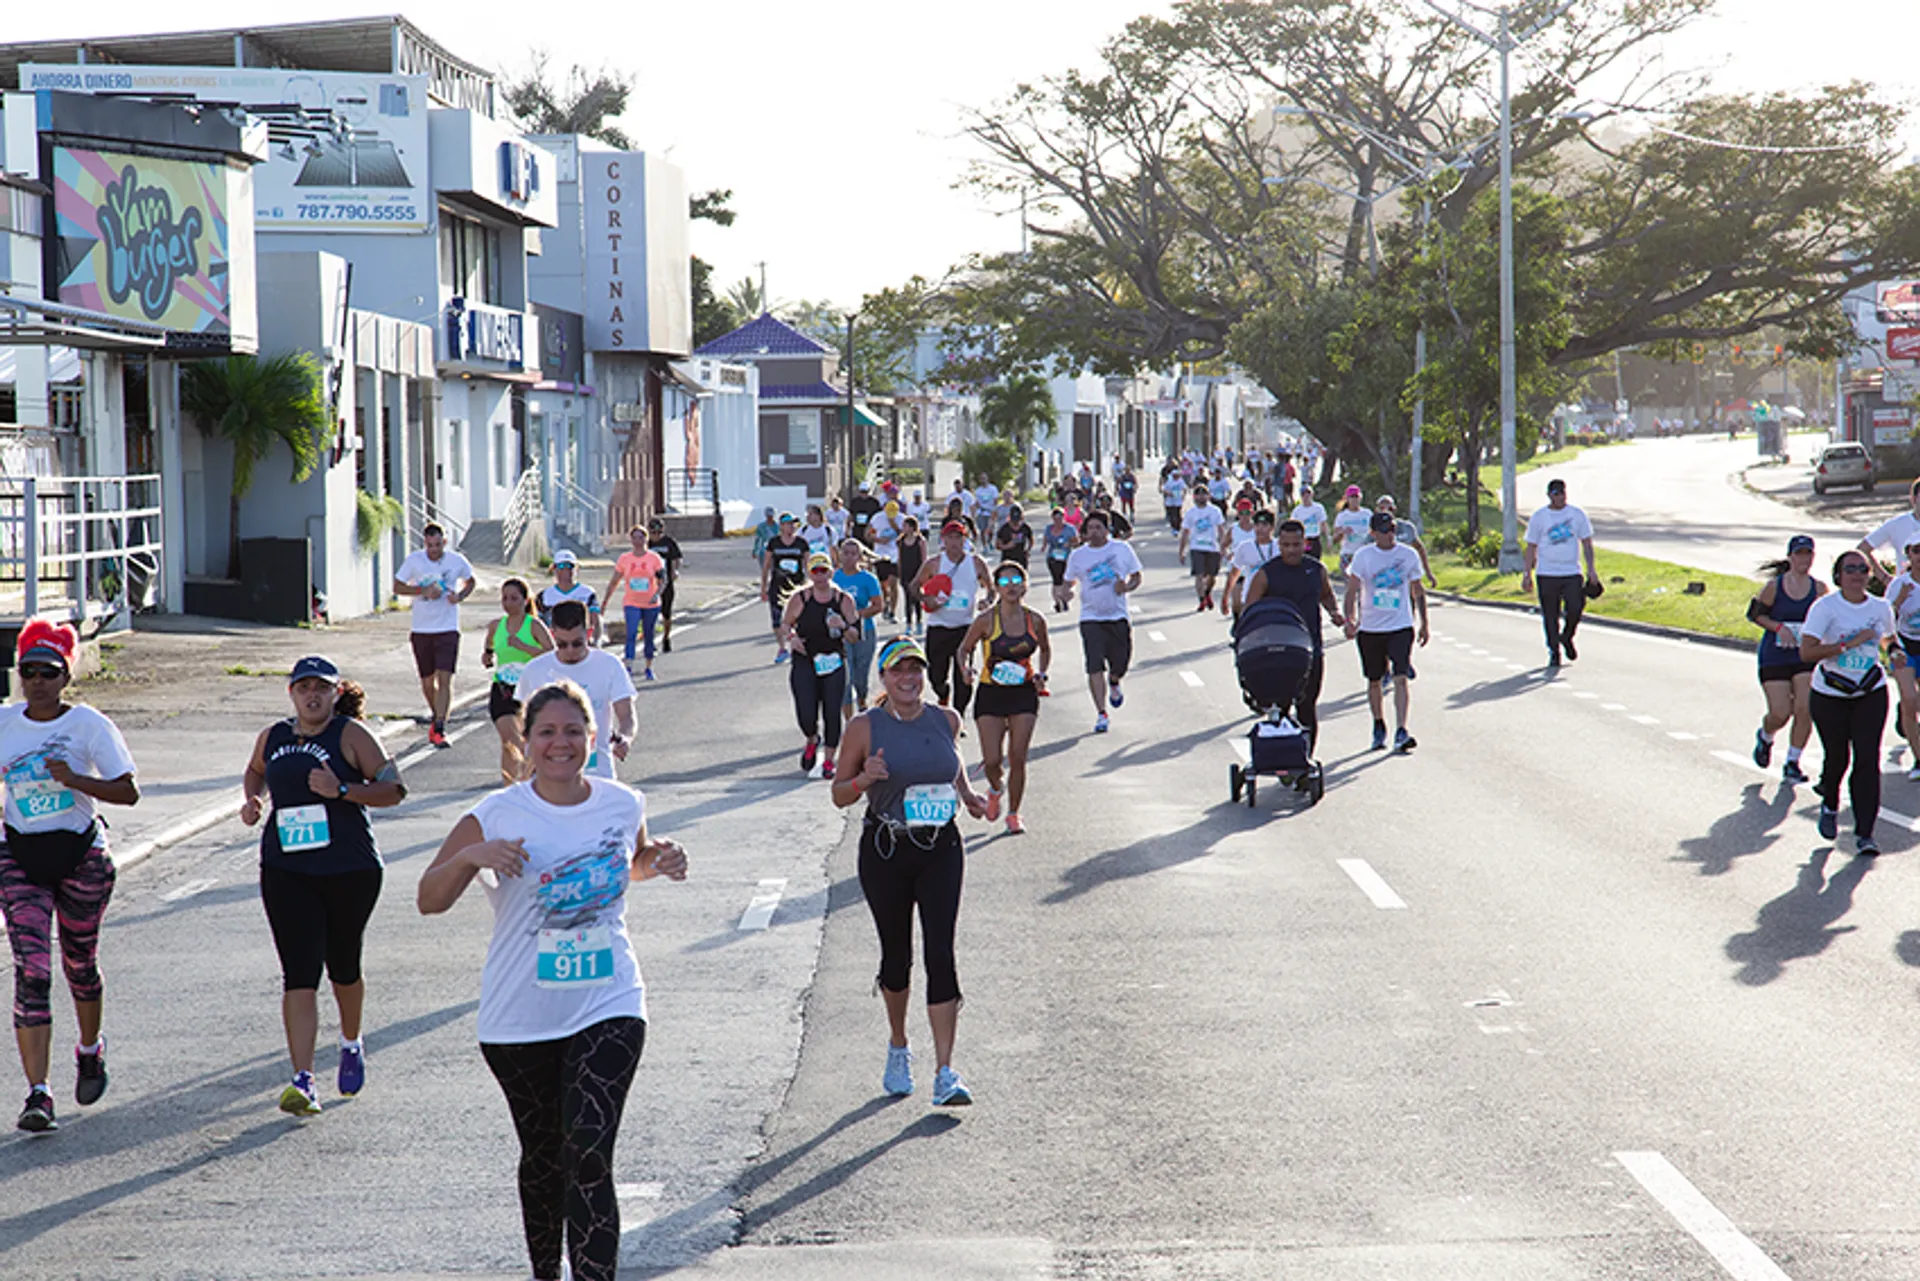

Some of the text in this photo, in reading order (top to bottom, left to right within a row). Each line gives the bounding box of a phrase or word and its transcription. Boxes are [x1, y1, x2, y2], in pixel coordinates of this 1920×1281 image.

[31, 72, 83, 89] AHORRA
[85, 73, 132, 90] DINERO
[109, 172, 169, 247] Yam
[297, 203, 417, 221] 787.790.5555
[100, 213, 199, 313] burger
[606, 161, 625, 347] CORTINAS
[28, 793, 61, 815] 827
[910, 801, 952, 819] 1079
[285, 823, 316, 843] 771
[550, 881, 583, 903] 5K
[554, 952, 597, 979] 911
